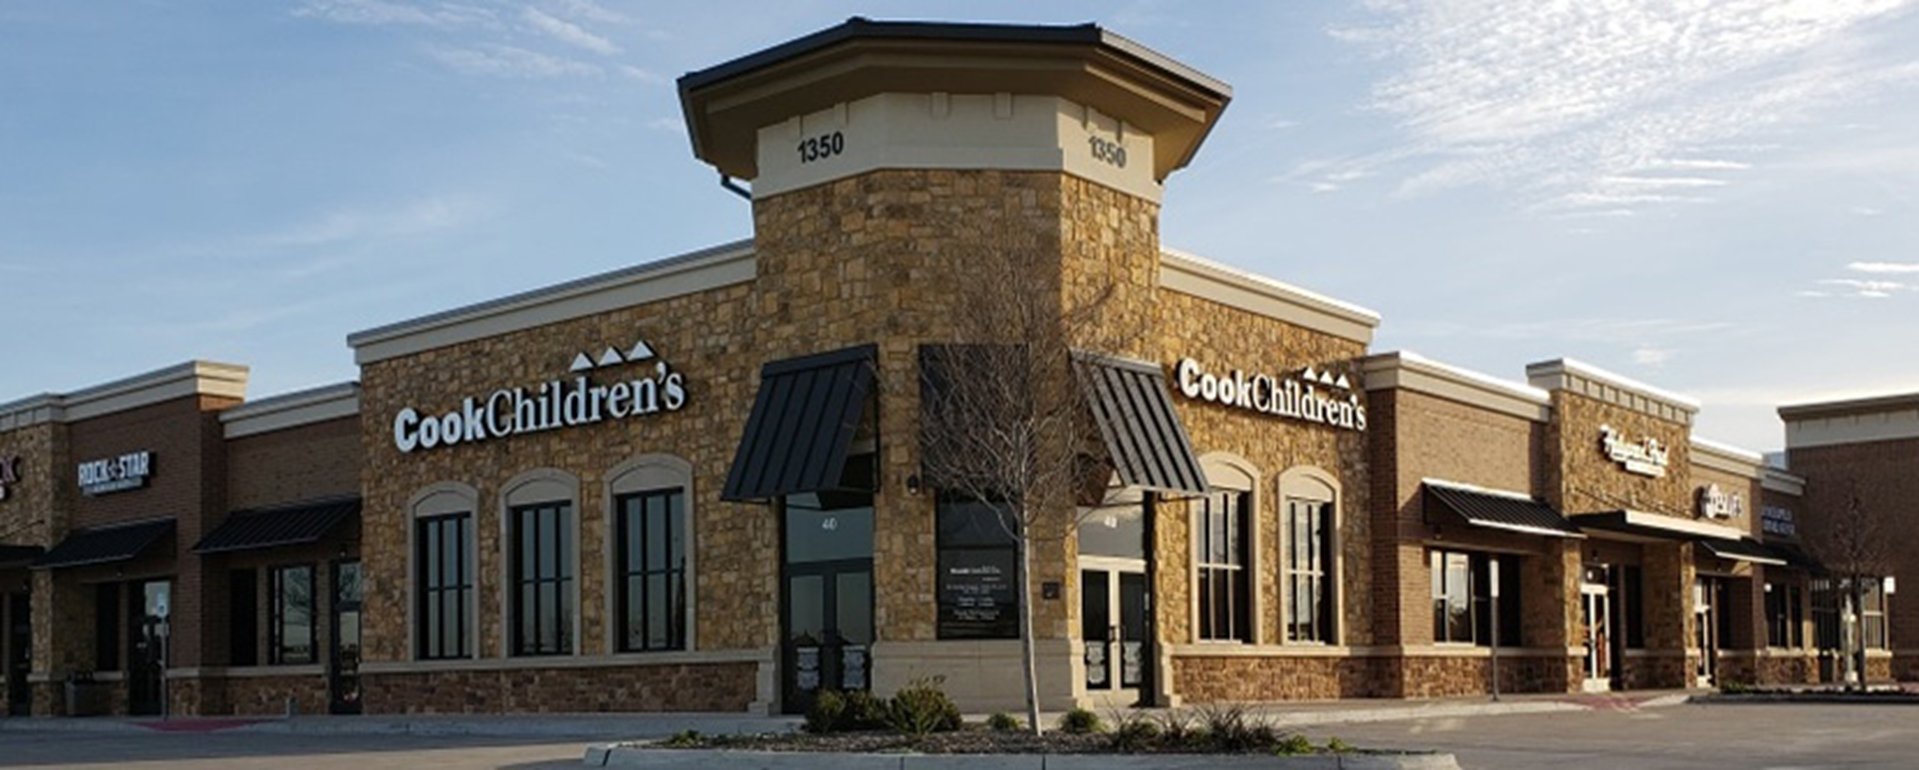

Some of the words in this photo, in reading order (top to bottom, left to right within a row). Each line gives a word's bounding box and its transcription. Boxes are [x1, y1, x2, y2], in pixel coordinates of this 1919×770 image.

[797, 131, 843, 163] 1350
[1088, 135, 1126, 168] 1350
[78, 460, 109, 487] ROCK
[119, 452, 149, 479] STAR
